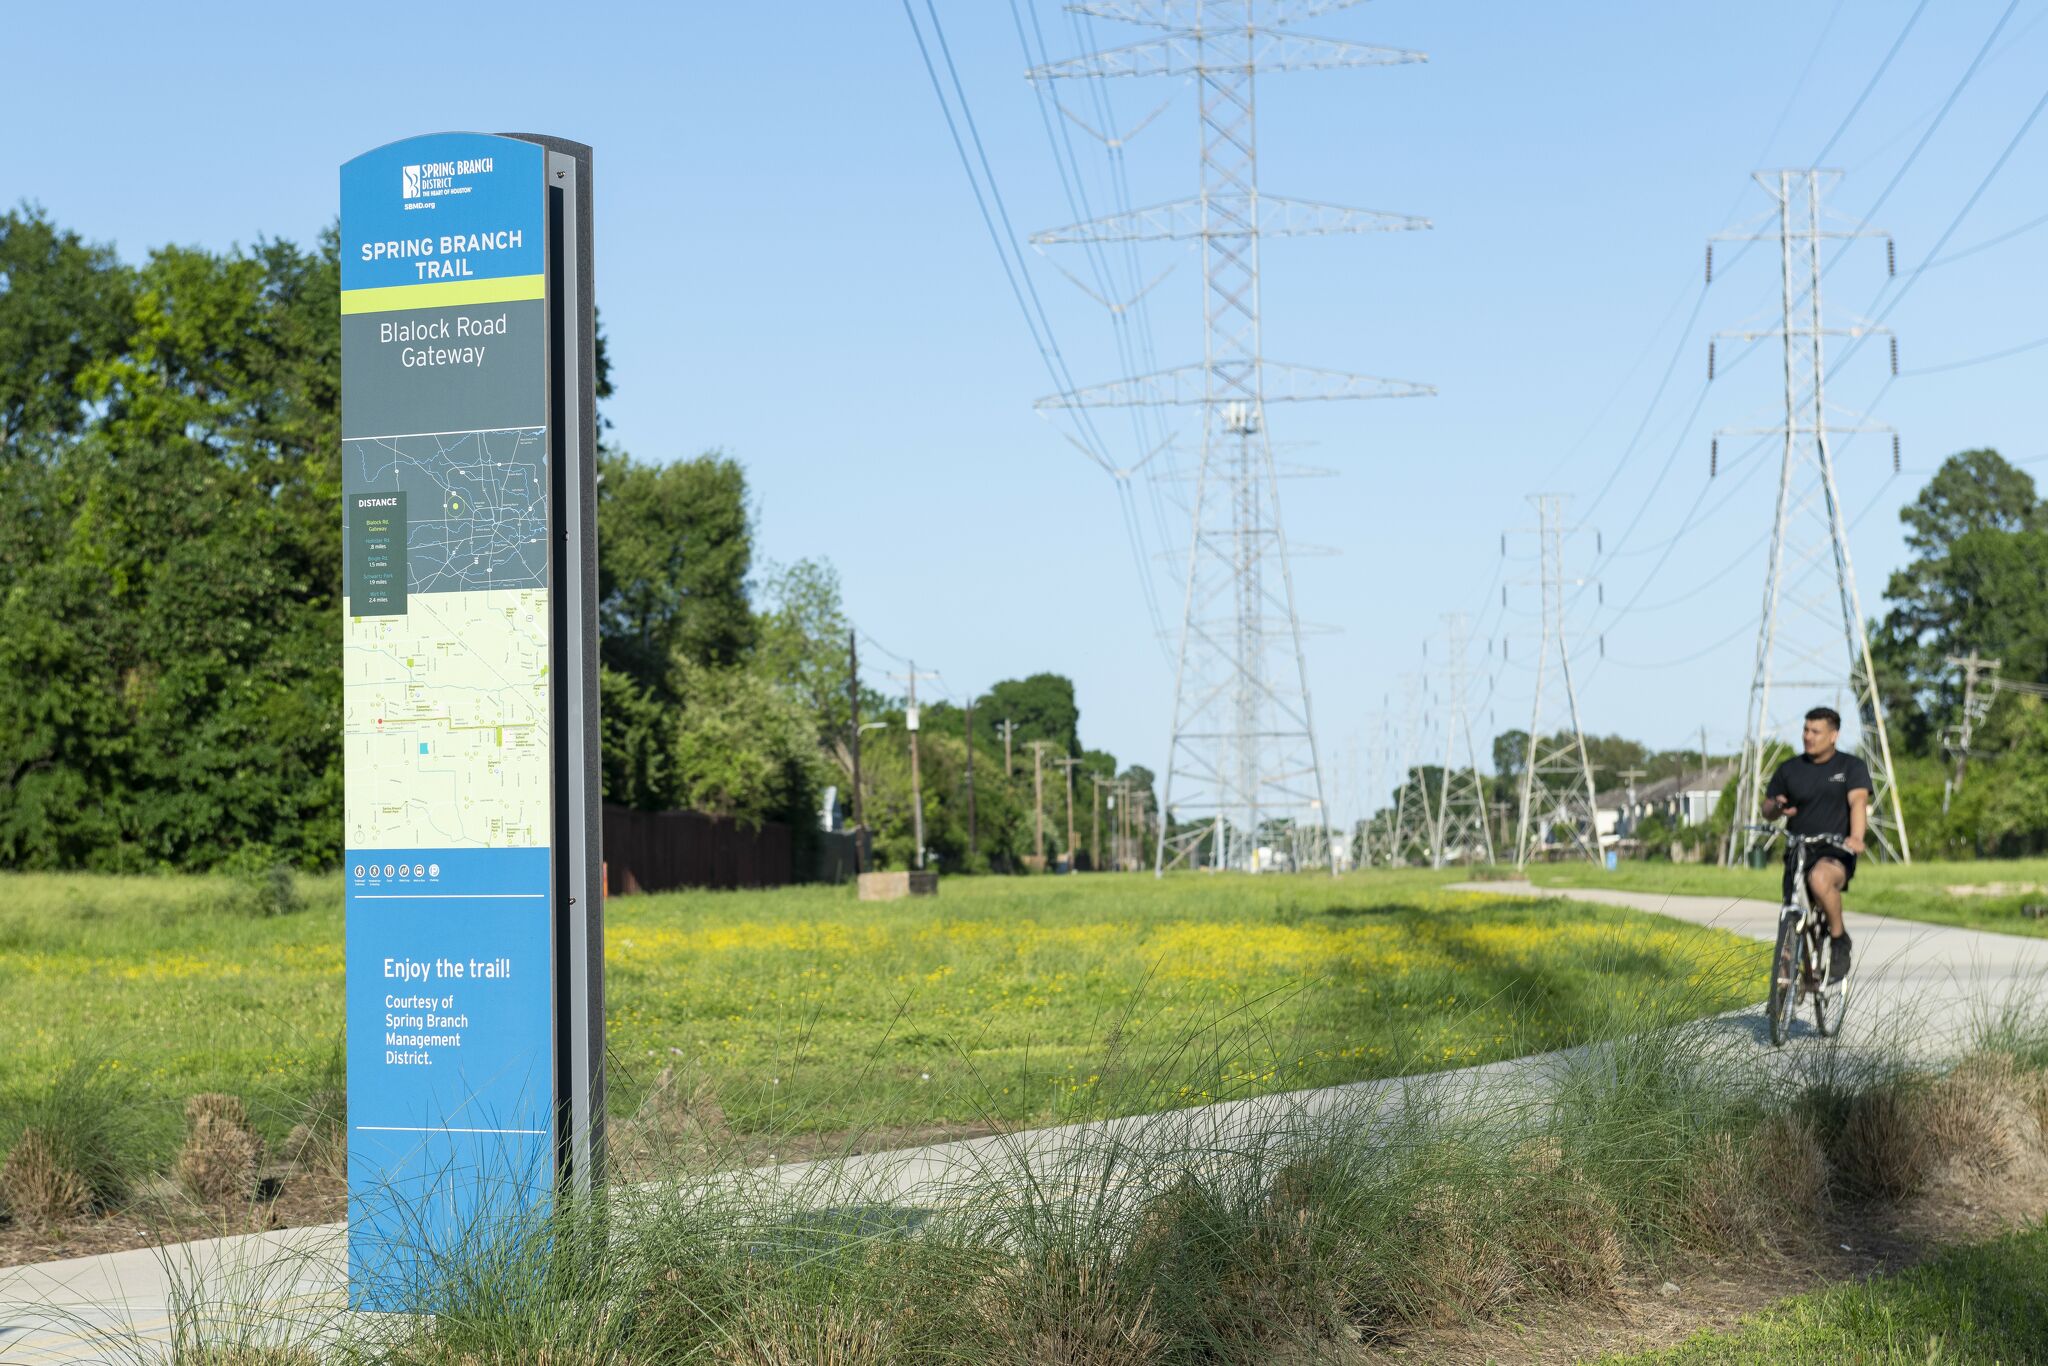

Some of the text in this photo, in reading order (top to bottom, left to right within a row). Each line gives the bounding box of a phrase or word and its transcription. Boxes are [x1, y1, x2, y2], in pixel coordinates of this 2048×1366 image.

[422, 158, 493, 178] SPRING BRANCH
[422, 177, 453, 190] DISTRICT
[404, 202, 436, 211] SBMD.org
[361, 229, 522, 261] SPRING BRANCH
[415, 258, 474, 280] TRAIL
[380, 313, 507, 343] Blalock Road
[402, 346, 486, 368] Gateway
[358, 497, 398, 508] DISTANCE
[384, 958, 511, 982] Enjoy the trail!
[385, 995, 454, 1012] Courtesy of
[385, 1013, 468, 1031] Spring Branch
[386, 1032, 461, 1049] Management
[386, 1050, 433, 1065] District.
